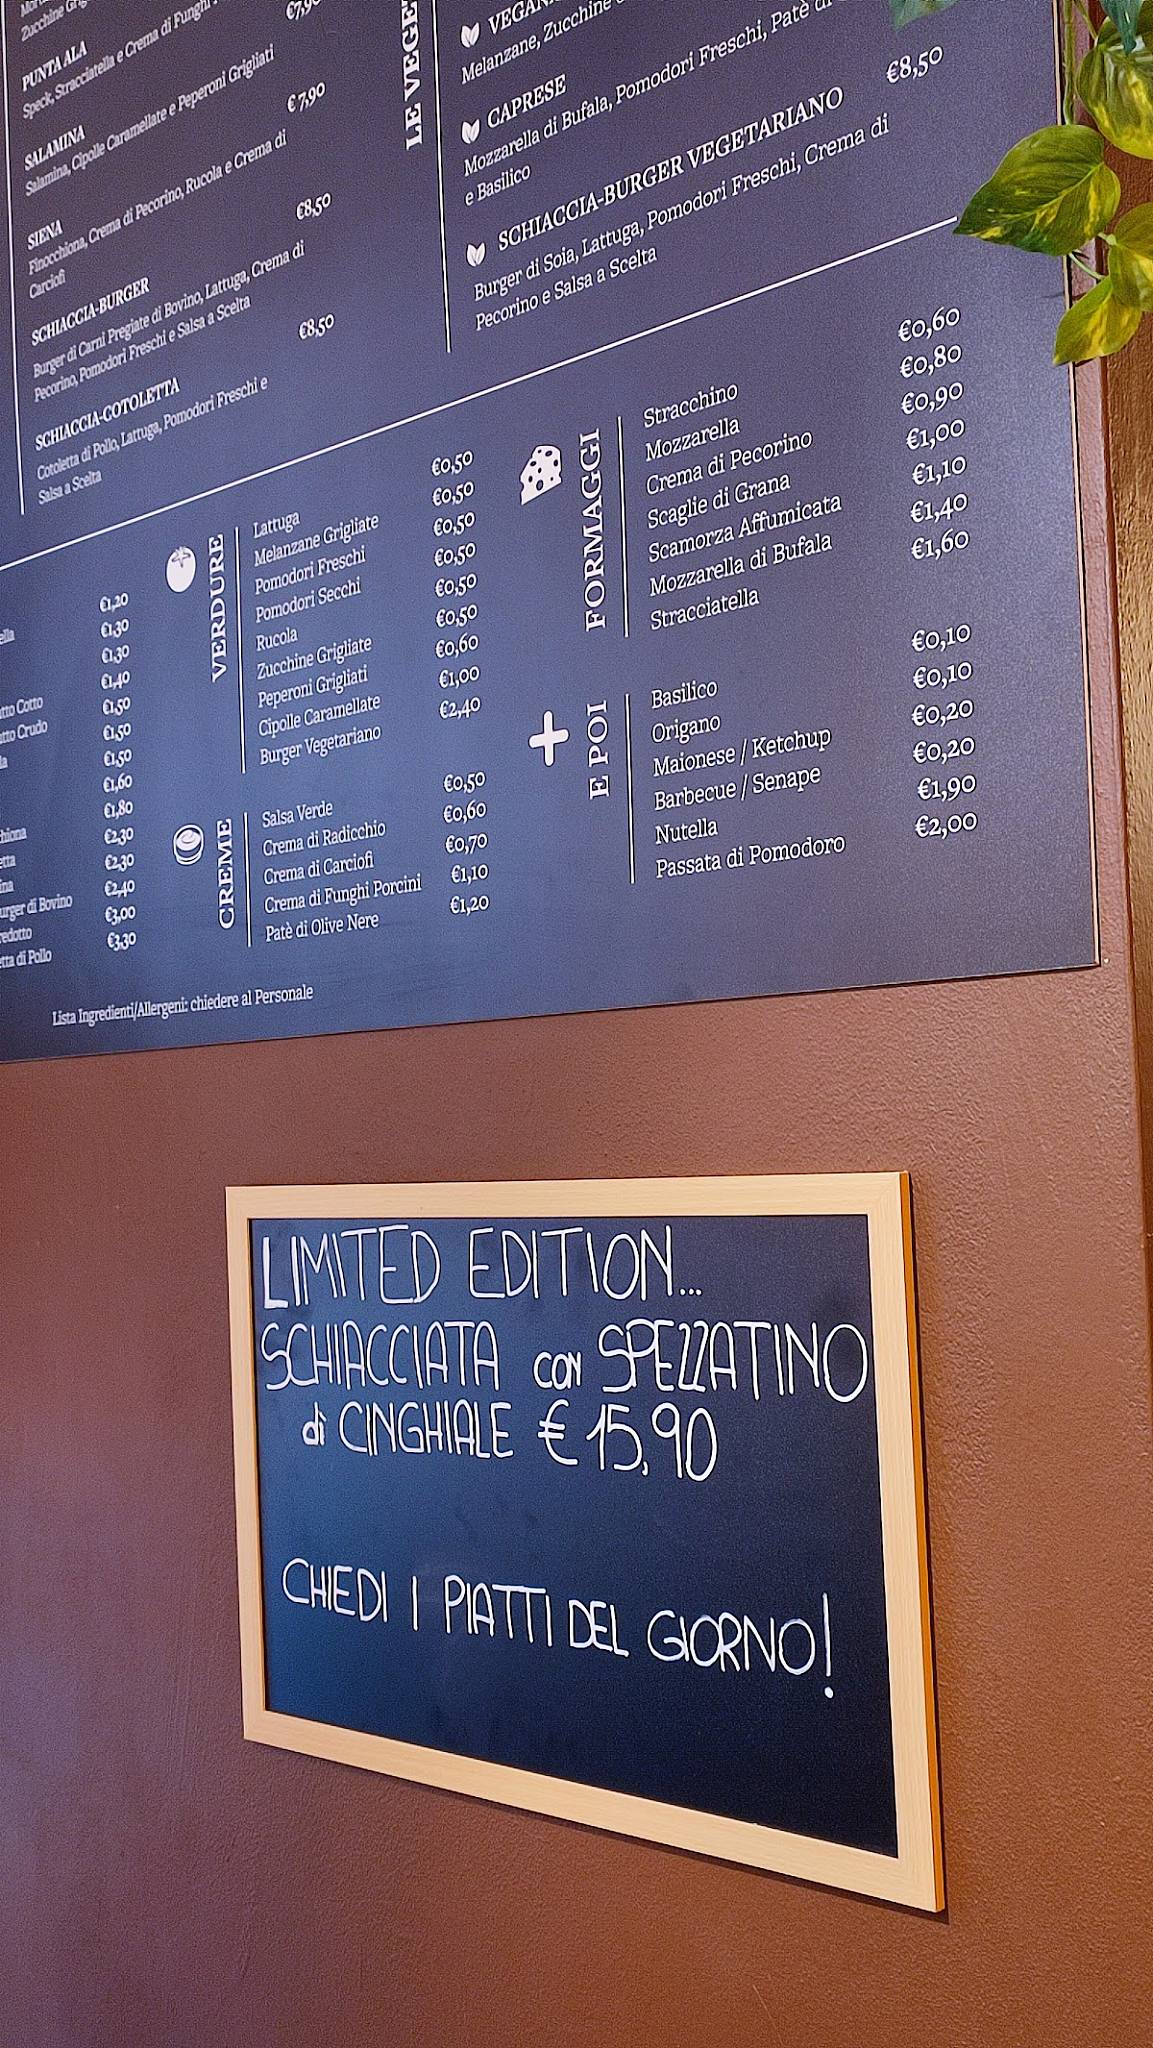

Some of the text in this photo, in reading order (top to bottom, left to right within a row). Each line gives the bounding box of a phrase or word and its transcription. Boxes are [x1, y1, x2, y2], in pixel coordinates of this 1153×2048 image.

[22, 40, 87, 92] PUNTA ALA
[401, 0, 423, 151] LE VEGE
[886, 46, 943, 83] €8,50
[464, 129, 540, 177] Mozzarella
[543, 115, 558, 139] di
[561, 96, 613, 131] Bufala,
[616, 51, 694, 105] Pomodori
[699, 19, 767, 67] Freschi,
[487, 74, 566, 128] CAPRESE
[24, 125, 85, 171] SALAMINA
[465, 165, 531, 206] e Basilico
[499, 87, 843, 250] SCHIACCIA-BURGER VEGETARIANO
[296, 193, 331, 220] €8,50
[474, 112, 889, 302] Burger di Soia, Lattuga, Pomodori Freschi, Crema di
[27, 219, 63, 250] SIENA
[31, 277, 149, 346] SCHIACCIA-BURGER
[299, 314, 334, 340] €8,50
[898, 306, 960, 342] €0,60
[899, 345, 961, 378] €0,80
[35, 378, 179, 451] SCHIACCIA-COTOLETTA
[644, 384, 738, 428] Stracchino
[901, 382, 963, 415] €0,90
[645, 417, 740, 462] Mozzarella
[906, 419, 964, 450] €1,00
[431, 450, 473, 476] €0,50
[646, 432, 812, 495] Crema di Pecorino
[912, 456, 966, 485] €1,10
[432, 481, 474, 506] €0,50
[648, 474, 791, 529] Scaglie di Grana
[910, 494, 967, 523] €1,40
[253, 512, 300, 539] Lattuga
[254, 515, 379, 567] Melanzane Grigliate
[433, 512, 475, 537] €0,50
[580, 429, 605, 631] FORMAGGI
[649, 496, 842, 563] Scamorza Affumicata
[434, 542, 476, 567] €0,50
[910, 528, 969, 560] €1,60
[255, 544, 366, 595] Pomodori Freschi
[650, 533, 832, 596] Mozzarella di Bufala
[256, 576, 361, 623] Pomodori Secchi
[435, 573, 477, 597] €0,50
[208, 534, 227, 682] VERDURE
[436, 604, 478, 628] €0,50
[651, 588, 759, 630] Stracciatella
[256, 627, 298, 652] Rucola
[435, 632, 479, 658] €0,60
[911, 624, 971, 652] €0,10
[257, 638, 372, 680] Zucchine Grigliate
[439, 666, 480, 689] €1,00
[913, 662, 972, 689] €0,10
[258, 664, 368, 709] Peperoni Grigliati
[651, 680, 717, 709] Basilico
[258, 696, 381, 739] Cipolle Caramellate
[439, 697, 481, 719] €2,40
[911, 700, 973, 727] €0,20
[260, 726, 381, 766] Burger Vegetariano
[652, 716, 721, 744] Origano
[587, 700, 610, 800] E POI
[653, 748, 735, 777] Maionese
[752, 729, 831, 758] Ketchup
[912, 737, 975, 765] €0,20
[443, 771, 486, 794] €0,50
[654, 782, 736, 811] Barbecue
[753, 767, 821, 794] Senape
[917, 775, 976, 802] €1,90
[262, 800, 333, 828] Salsa Verde
[443, 799, 486, 824] €0,60
[915, 812, 977, 839] €2,00
[263, 819, 386, 856] Crema di Radicchio
[445, 833, 488, 855] €0,70
[655, 818, 718, 845] Nutella
[216, 818, 235, 929] CREME
[264, 850, 374, 885] Crema di Carciofi
[451, 864, 488, 885] €1,10
[656, 836, 845, 878] Passata di Pomodoro
[264, 873, 422, 914] Crema di Funghi Porcini
[450, 895, 489, 916] €1,20
[295, 919, 309, 938] di
[311, 916, 344, 936] Olive
[347, 913, 379, 931] Nere
[52, 1010, 77, 1026] Lista
[190, 993, 239, 1012] chiedere
[241, 989, 252, 1007] al
[254, 984, 314, 1005] Personale
[262, 1224, 702, 1309] LIMITED EDITION...
[260, 1318, 868, 1403] SCHIACCIATA con SPEZZATINO
[339, 1398, 514, 1459] CINGHIALE
[537, 1398, 578, 1466] €
[585, 1402, 718, 1482] 15,90
[282, 1557, 834, 1699] CHIEDI I PIATTI DEL GIORNO!
